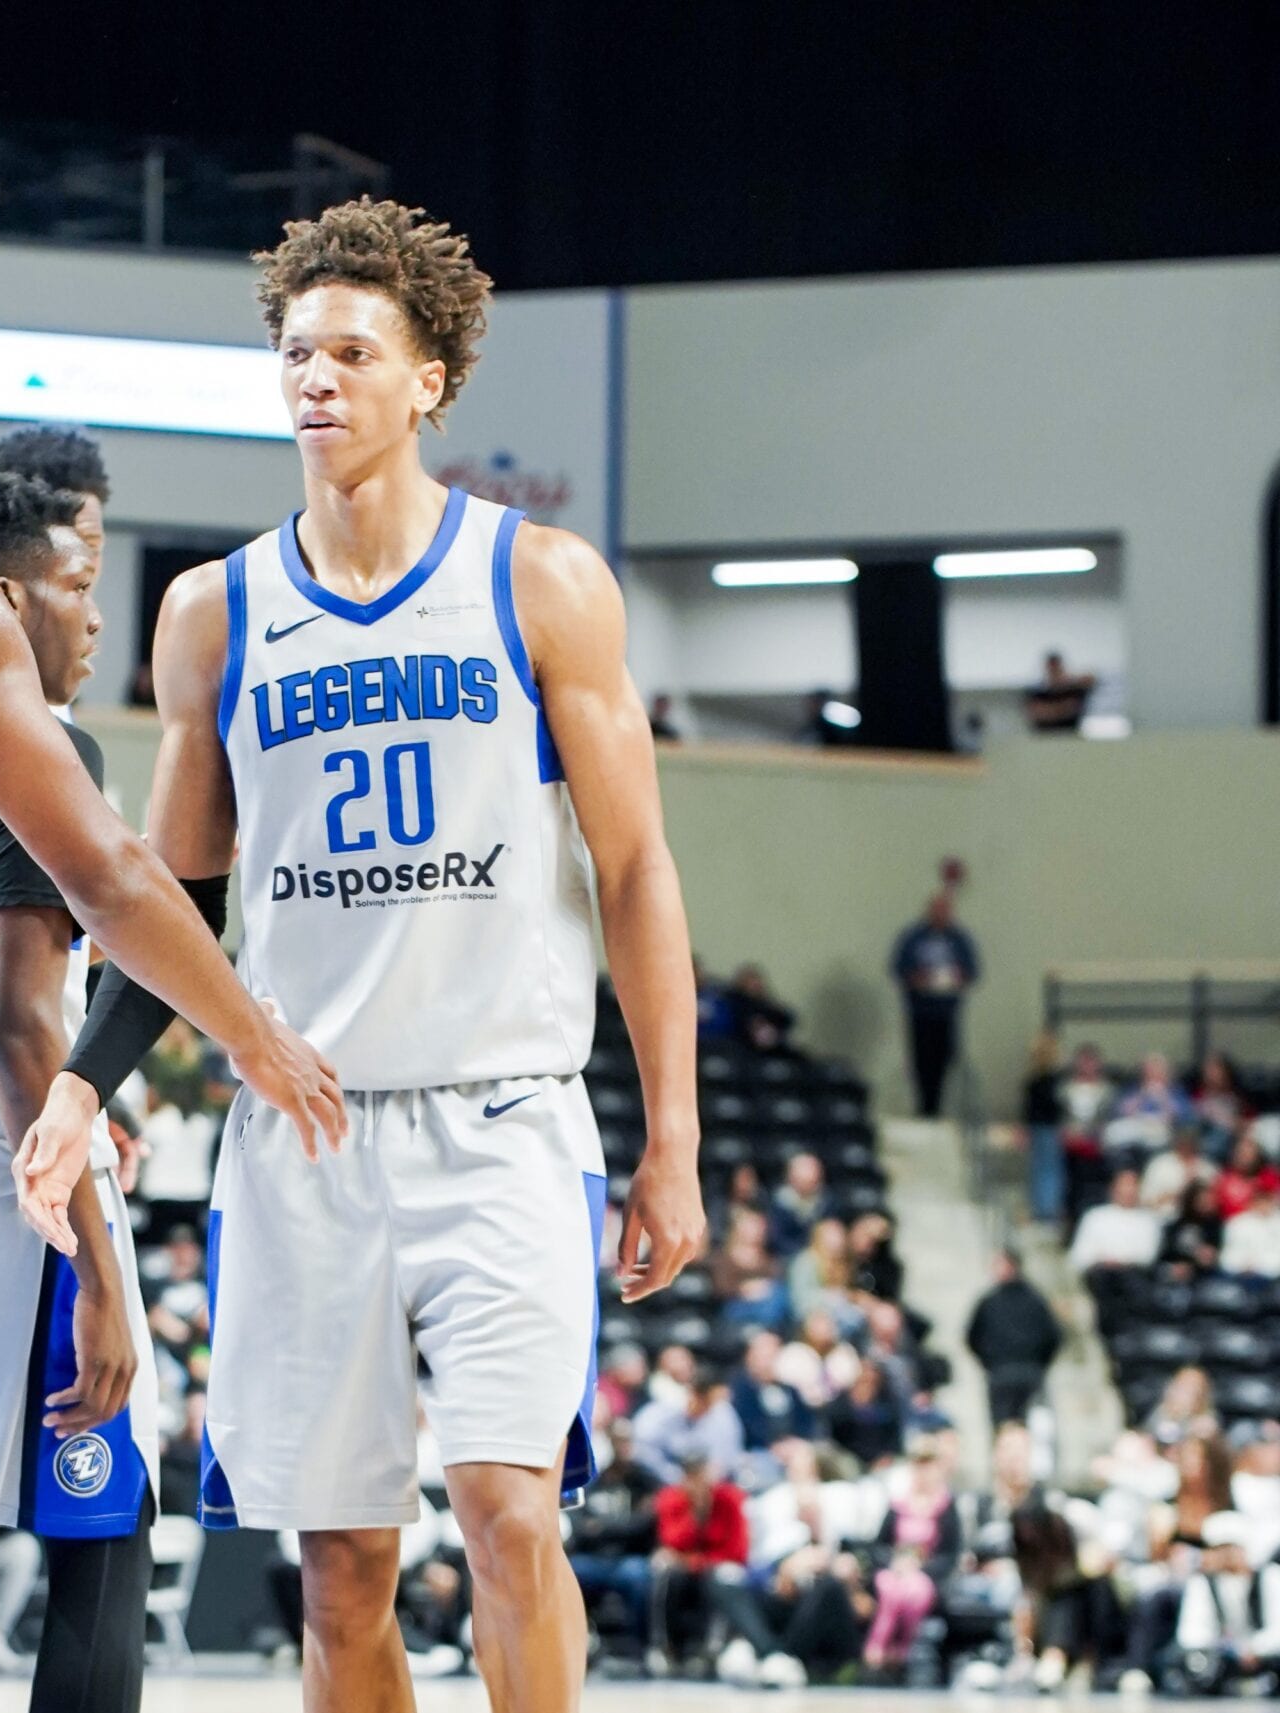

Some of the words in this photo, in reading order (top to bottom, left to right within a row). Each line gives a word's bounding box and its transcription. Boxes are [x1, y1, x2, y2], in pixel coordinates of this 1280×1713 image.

[250, 655, 498, 752] LEGENDS
[323, 741, 436, 854] 20
[355, 899, 386, 908] Solving
[388, 898, 399, 906] the
[401, 896, 431, 905] problem
[441, 893, 458, 902] drug
[460, 892, 498, 900] disposal
